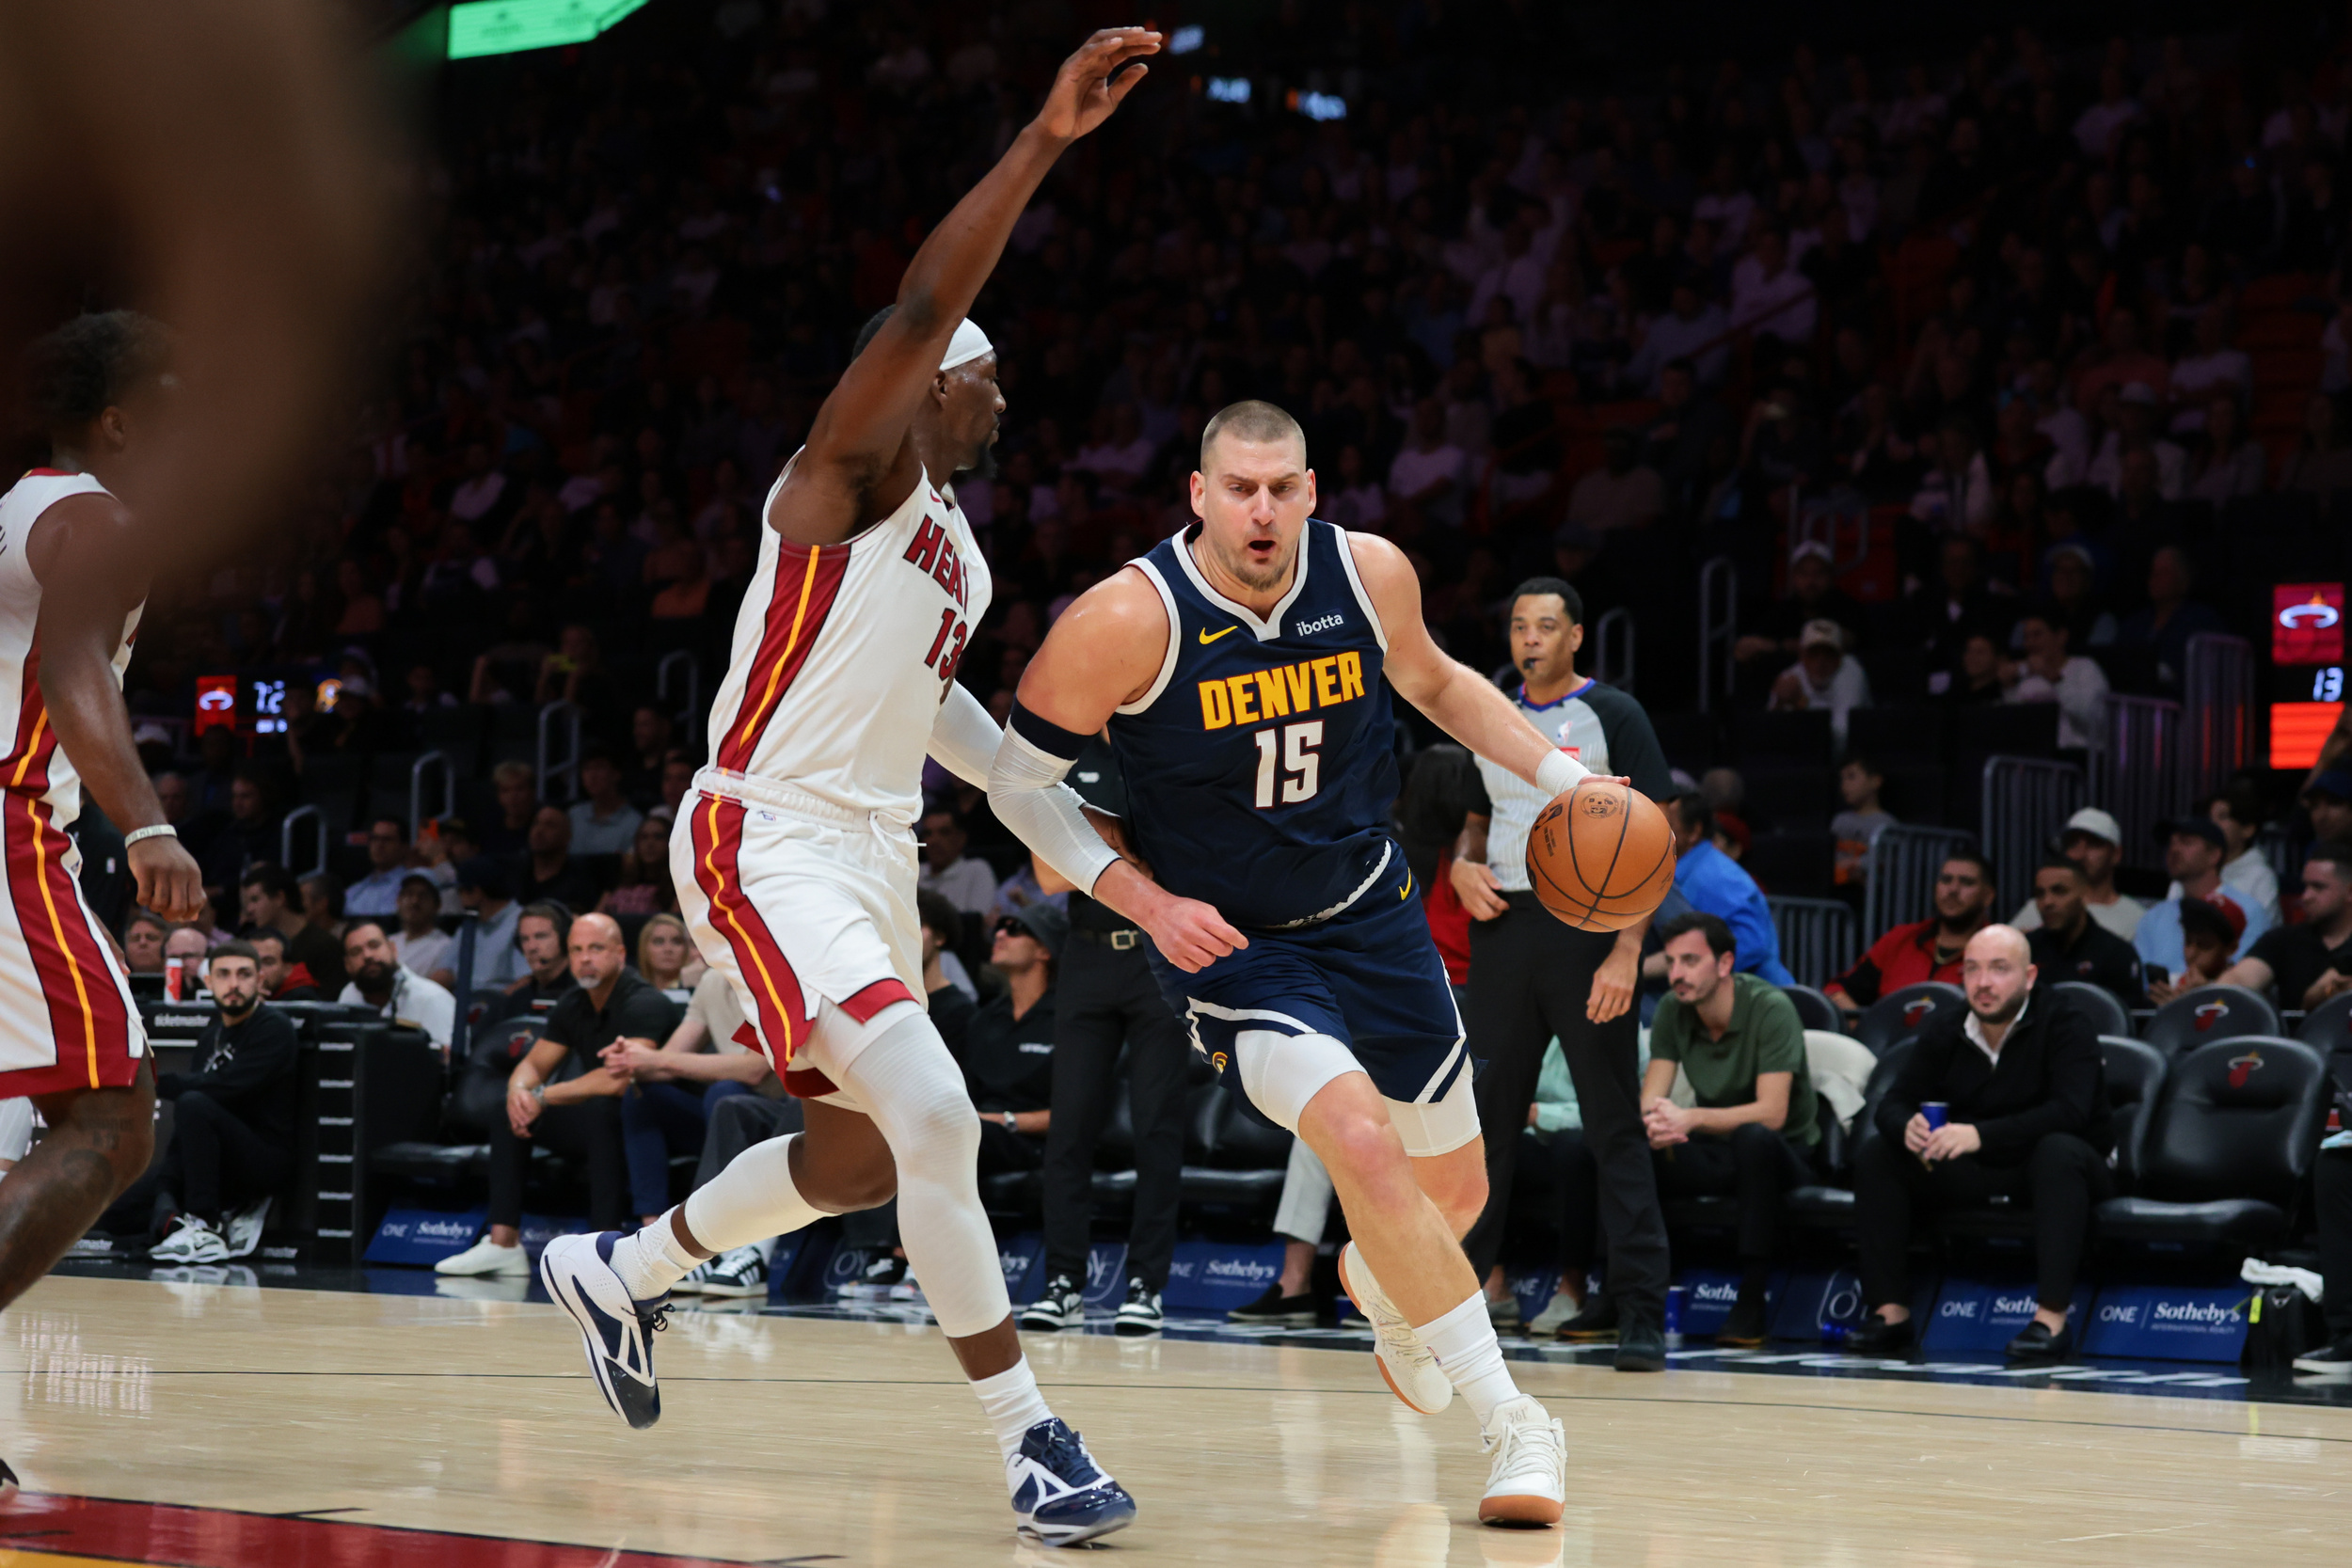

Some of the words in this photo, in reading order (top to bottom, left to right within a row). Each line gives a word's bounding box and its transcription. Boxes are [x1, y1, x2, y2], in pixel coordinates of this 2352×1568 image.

[1296, 613, 1343, 637] ibotta
[924, 608, 967, 682] 13
[1198, 651, 1365, 731] DENVER
[2312, 667, 2344, 702] 13
[1254, 720, 1325, 810] 15
[154, 1013, 211, 1027] ticketmaster
[1941, 1301, 1977, 1318] ONE
[2100, 1305, 2138, 1323] ONE
[2154, 1301, 2241, 1325] Sotheby's
